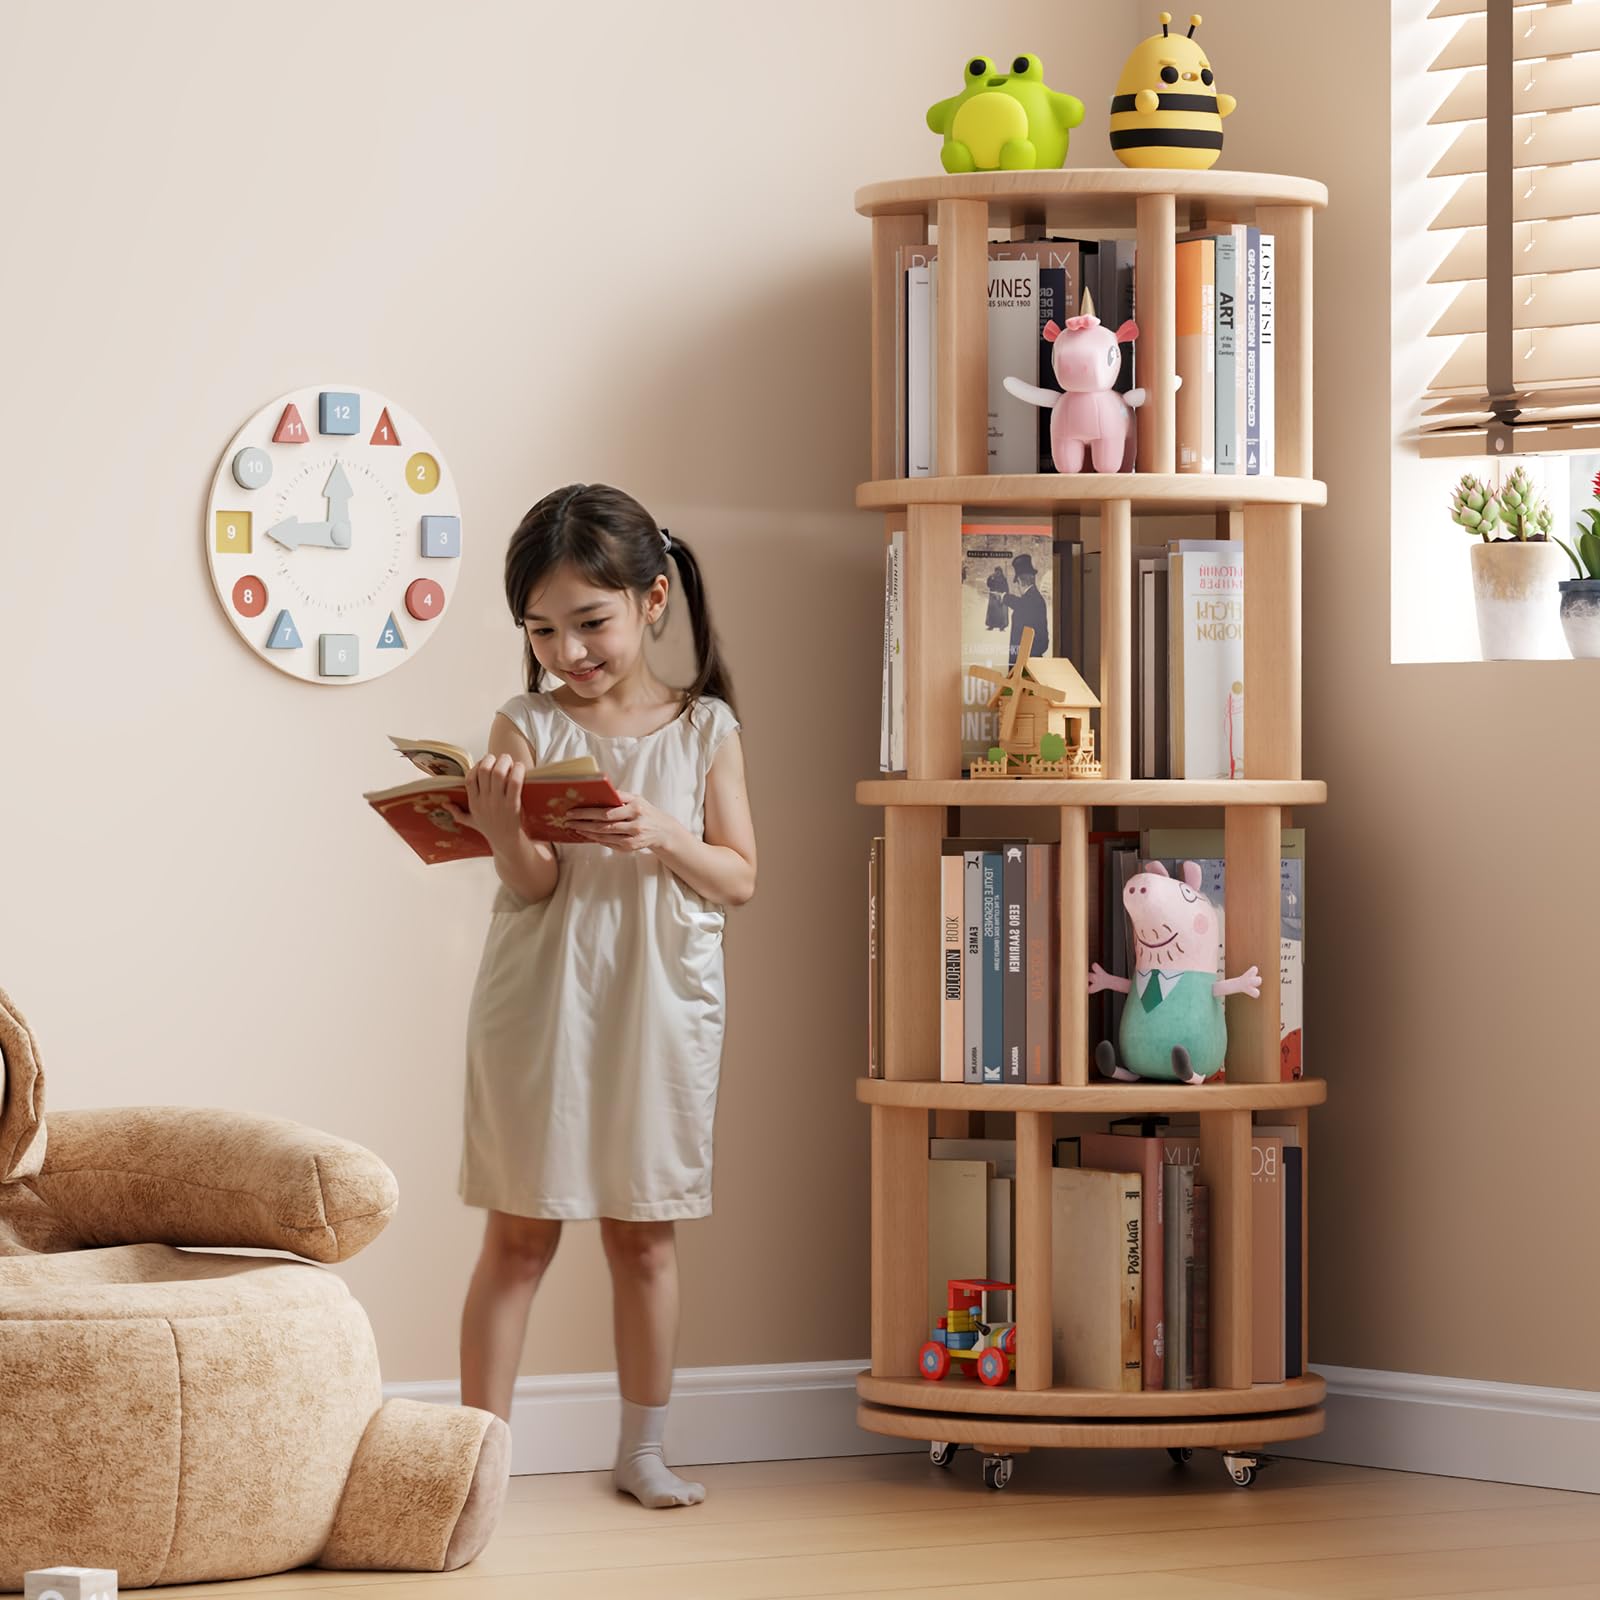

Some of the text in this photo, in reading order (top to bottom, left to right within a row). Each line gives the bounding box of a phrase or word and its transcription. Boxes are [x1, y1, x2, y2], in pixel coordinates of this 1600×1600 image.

[1248, 249, 1256, 302] GRAPHIC
[997, 300, 1014, 308] SINCE
[1219, 291, 1234, 330] ART
[1248, 304, 1256, 348] DESIGN
[334, 406, 350, 419] 12
[288, 423, 302, 435] 11
[381, 427, 388, 441] 1
[249, 462, 263, 473] 10
[417, 466, 425, 480] 2
[227, 526, 236, 539] 9
[440, 533, 448, 544] 3
[244, 589, 253, 604] 8
[424, 593, 432, 606] 4
[284, 628, 292, 641] 7
[385, 630, 394, 644] 5
[338, 650, 347, 662] 6
[946, 916, 959, 942] BOOK
